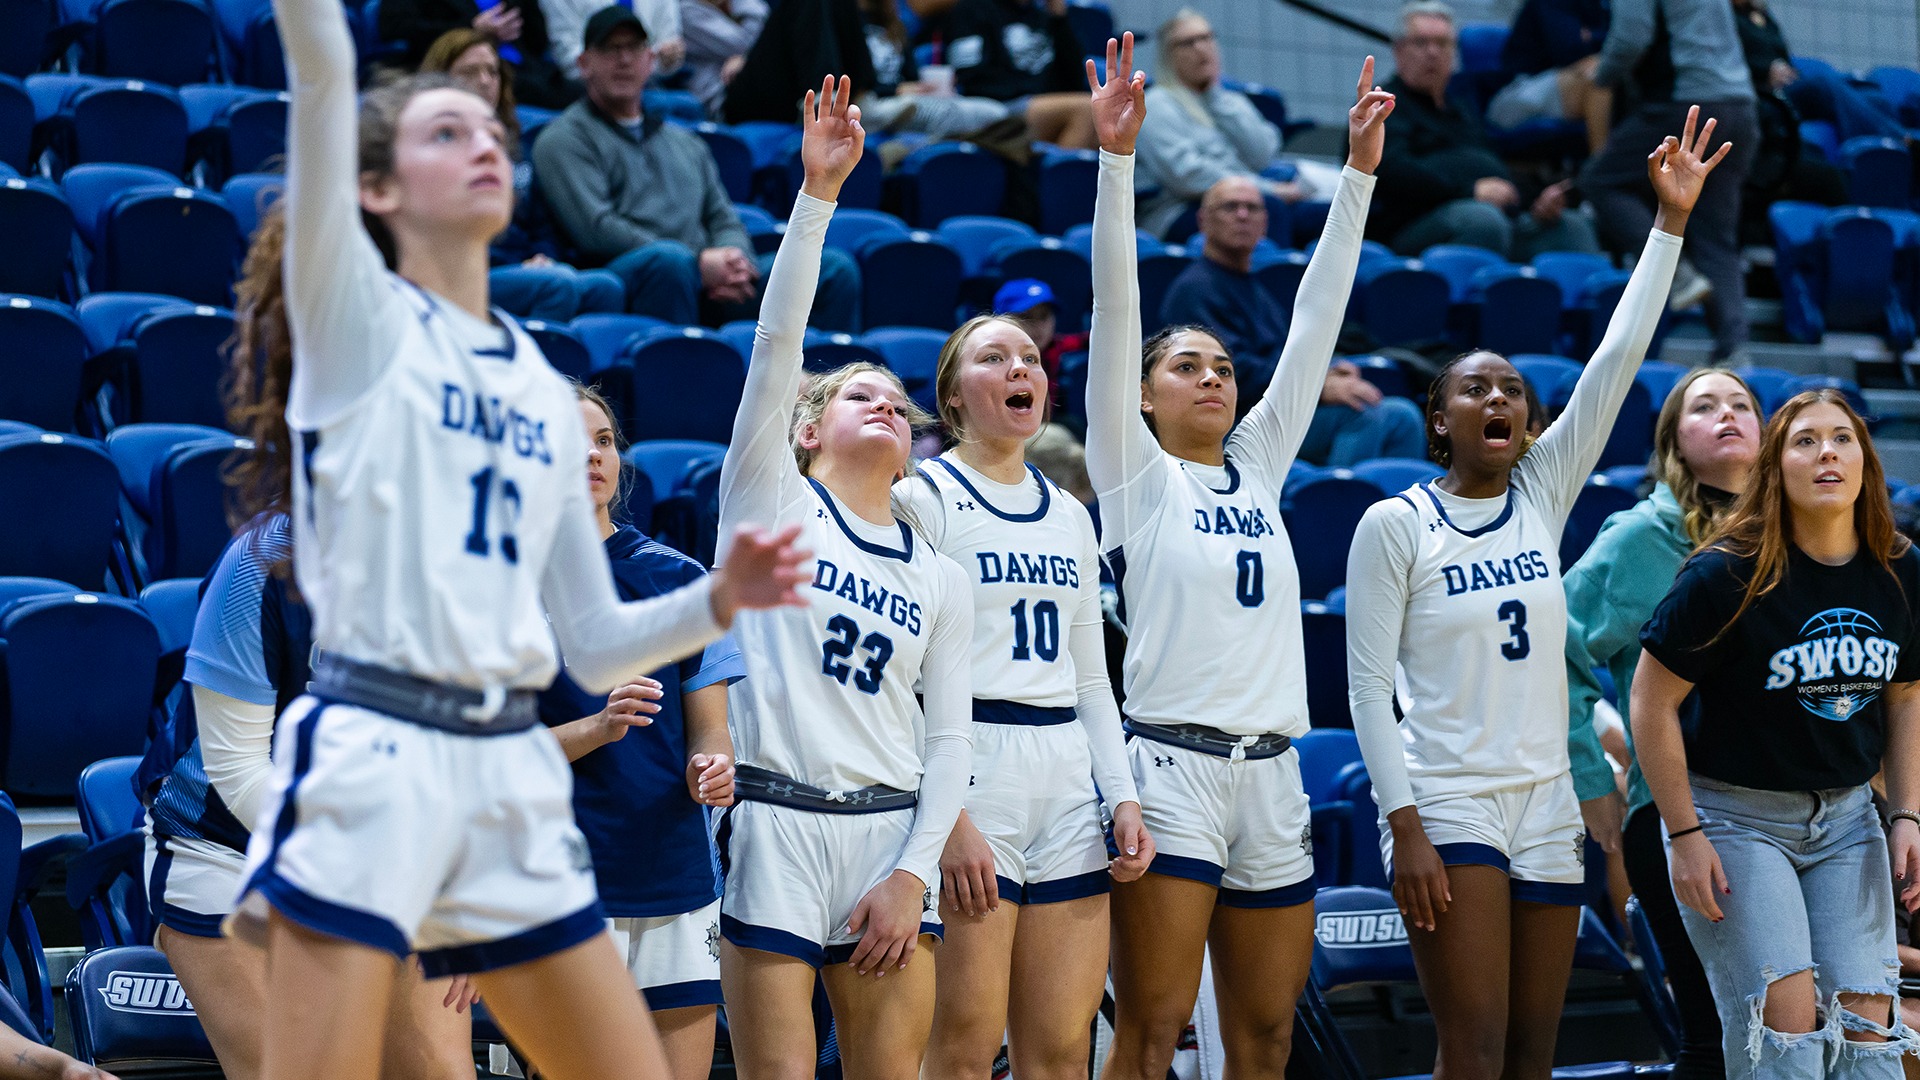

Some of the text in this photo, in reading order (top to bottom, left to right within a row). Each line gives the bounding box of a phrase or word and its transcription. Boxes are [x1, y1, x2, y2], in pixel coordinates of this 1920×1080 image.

[811, 559, 922, 637] DAWGS
[976, 552, 1079, 589] DAWGS
[1236, 549, 1265, 608] 0
[1441, 550, 1549, 596] DAWGS
[822, 613, 894, 696] 23
[1010, 598, 1059, 663] 10
[1497, 599, 1530, 662] 3
[1797, 684, 1839, 693] WOMEN'S
[108, 976, 194, 1010] SWO
